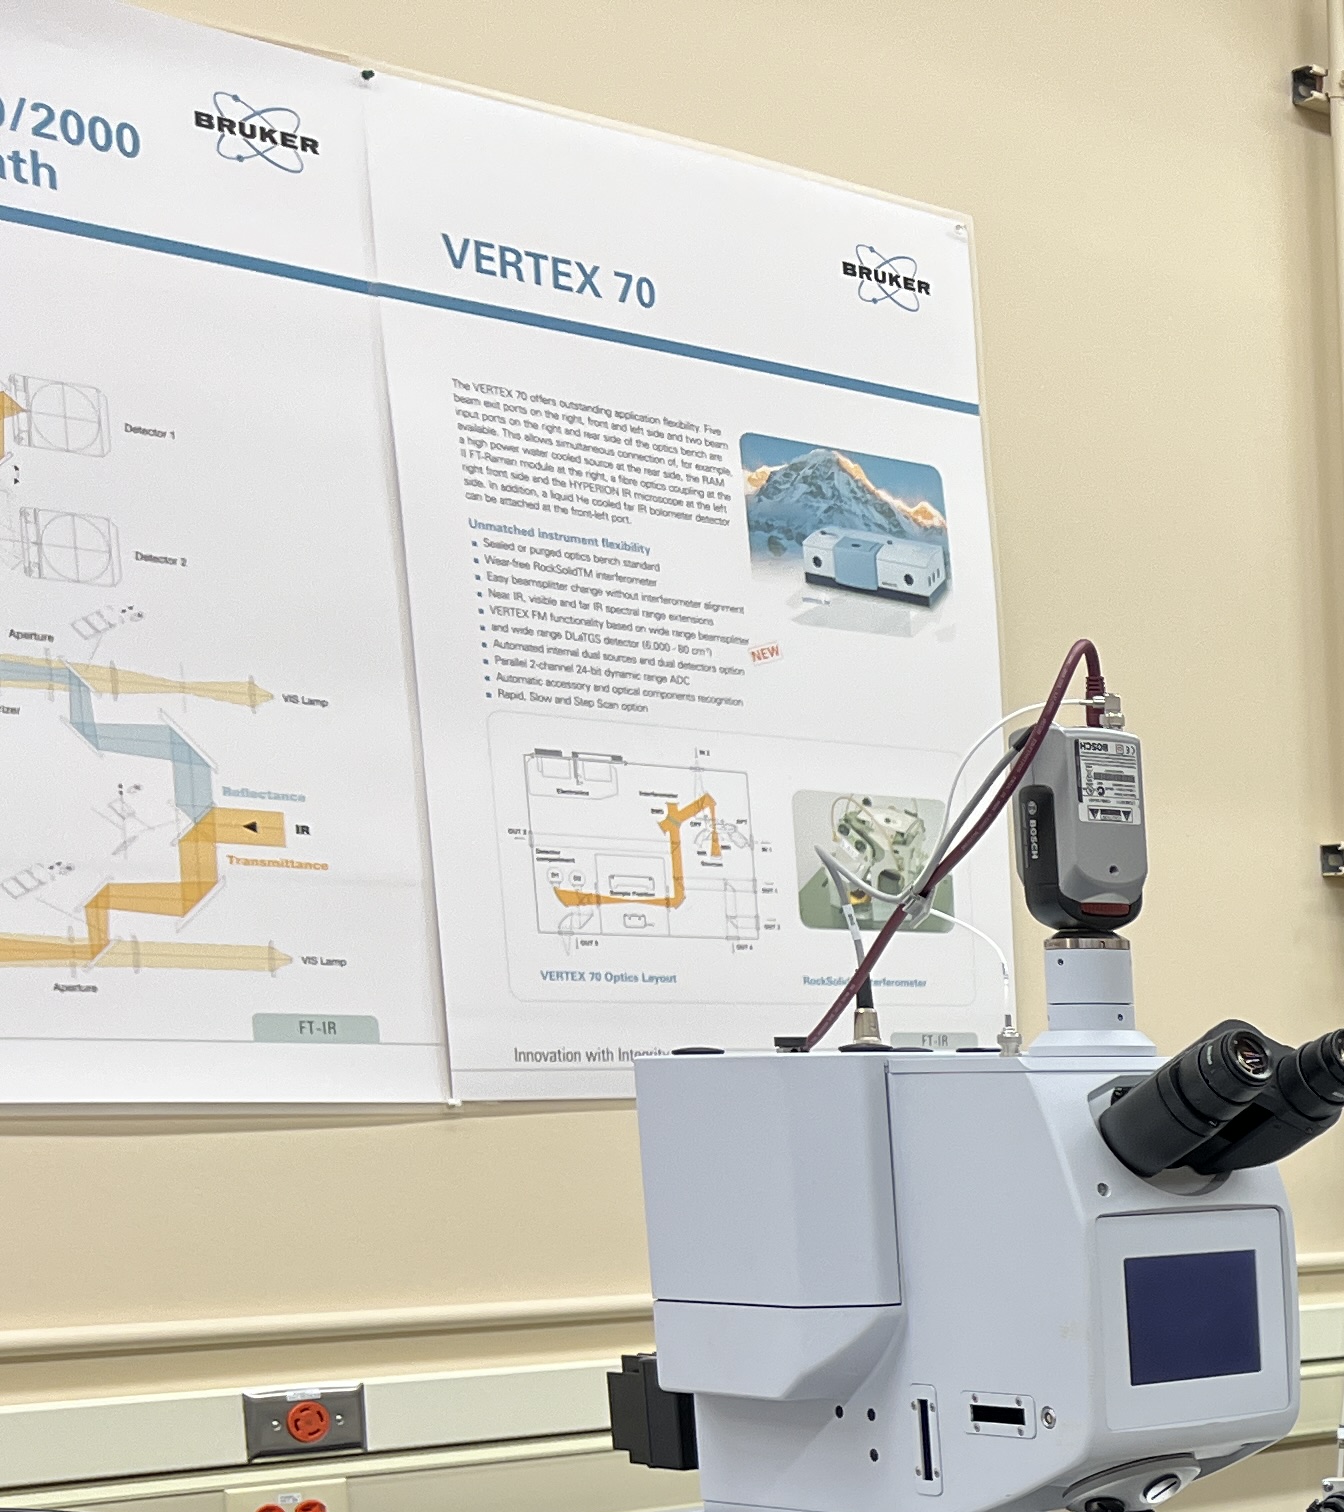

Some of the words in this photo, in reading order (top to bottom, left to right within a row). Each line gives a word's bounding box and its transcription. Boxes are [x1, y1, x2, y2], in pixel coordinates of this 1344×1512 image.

[0, 96, 141, 159] /2000
[194, 110, 319, 154] BRUKER
[0, 149, 57, 190] th
[441, 233, 602, 299] VERTEX
[613, 270, 656, 308] 70
[842, 260, 930, 296] BRUKER
[451, 377, 471, 391] The
[472, 381, 513, 398] VERTEX
[514, 389, 528, 401] 70
[529, 392, 556, 406] offers
[558, 397, 612, 418] outstanding
[613, 407, 660, 427] application
[703, 424, 721, 436] Five
[124, 422, 166, 439] Detector
[453, 392, 481, 407] beam
[502, 401, 527, 417] ports
[528, 408, 542, 418] on
[543, 409, 559, 421] the
[586, 416, 608, 429] front
[610, 420, 627, 433] and
[629, 424, 644, 436] left
[645, 427, 664, 439] side
[666, 431, 683, 443] and
[684, 434, 702, 446] two
[703, 437, 728, 451] beam
[467, 517, 534, 537] Unmatched
[537, 528, 598, 547] instrument
[601, 538, 650, 556] flexibility
[135, 550, 177, 565] Detector
[482, 537, 515, 551] Sealed
[517, 544, 527, 553] or
[528, 544, 562, 560] purged
[592, 554, 620, 567] bench
[622, 558, 660, 573] standard
[483, 553, 530, 569] Wear-free
[532, 560, 593, 578] RockSolidTM
[595, 569, 656, 587] interferometer
[486, 570, 509, 585] Easy
[570, 582, 603, 598] change
[604, 587, 638, 601] without
[640, 592, 701, 609] interferometer
[487, 587, 510, 599] Near
[528, 593, 557, 606] visible
[559, 597, 576, 608] and
[578, 599, 590, 610] far
[592, 601, 603, 612] IR
[604, 603, 639, 618] spectral
[641, 610, 666, 622] range
[668, 612, 714, 626] extensions
[8, 628, 55, 643] Aperture
[488, 604, 529, 618] VERTEX
[531, 610, 547, 621] FM
[549, 612, 604, 630] functionality
[605, 619, 633, 632] based
[634, 625, 646, 633] on
[648, 625, 669, 636] wide
[671, 629, 696, 641] range
[490, 621, 509, 632] and
[510, 623, 534, 635] wide
[535, 628, 562, 641] range
[603, 635, 639, 648] detector
[492, 638, 544, 653] Automated
[545, 644, 579, 657] internal
[581, 648, 600, 659] dual
[602, 652, 636, 663] sources
[638, 655, 656, 666] and
[657, 657, 675, 668] dual
[677, 660, 716, 673] detectors
[718, 665, 745, 678] option
[751, 644, 780, 663] NEW
[493, 654, 527, 667] Parallel
[529, 659, 574, 672] 2-channel
[575, 664, 602, 675] 24-bit
[603, 667, 640, 682] dynamic
[642, 673, 667, 685] range
[669, 675, 690, 685] ADC
[495, 671, 543, 685] Automatic
[593, 682, 610, 692] and
[611, 684, 640, 697] optical
[302, 696, 329, 708] Lamp
[528, 692, 552, 703] Slow
[554, 694, 571, 705] and
[573, 696, 594, 709] Step
[596, 699, 619, 709] Scan
[620, 701, 648, 714] option
[1080, 741, 1109, 753] BOSCH
[222, 785, 306, 803] Reflectance
[295, 823, 311, 836] IR
[1028, 819, 1039, 860] BOSCH
[226, 854, 329, 871] Transmittance
[320, 957, 347, 968] Lamp
[53, 982, 99, 994] Aperture
[540, 970, 586, 982] VERTEX
[588, 971, 602, 983] 70
[604, 972, 639, 985] Optics
[641, 973, 678, 987] Layout
[299, 1020, 337, 1036] FT-IR
[921, 1034, 949, 1047] FT-IR
[514, 1047, 582, 1063] Innovation
[585, 1046, 615, 1062] with
